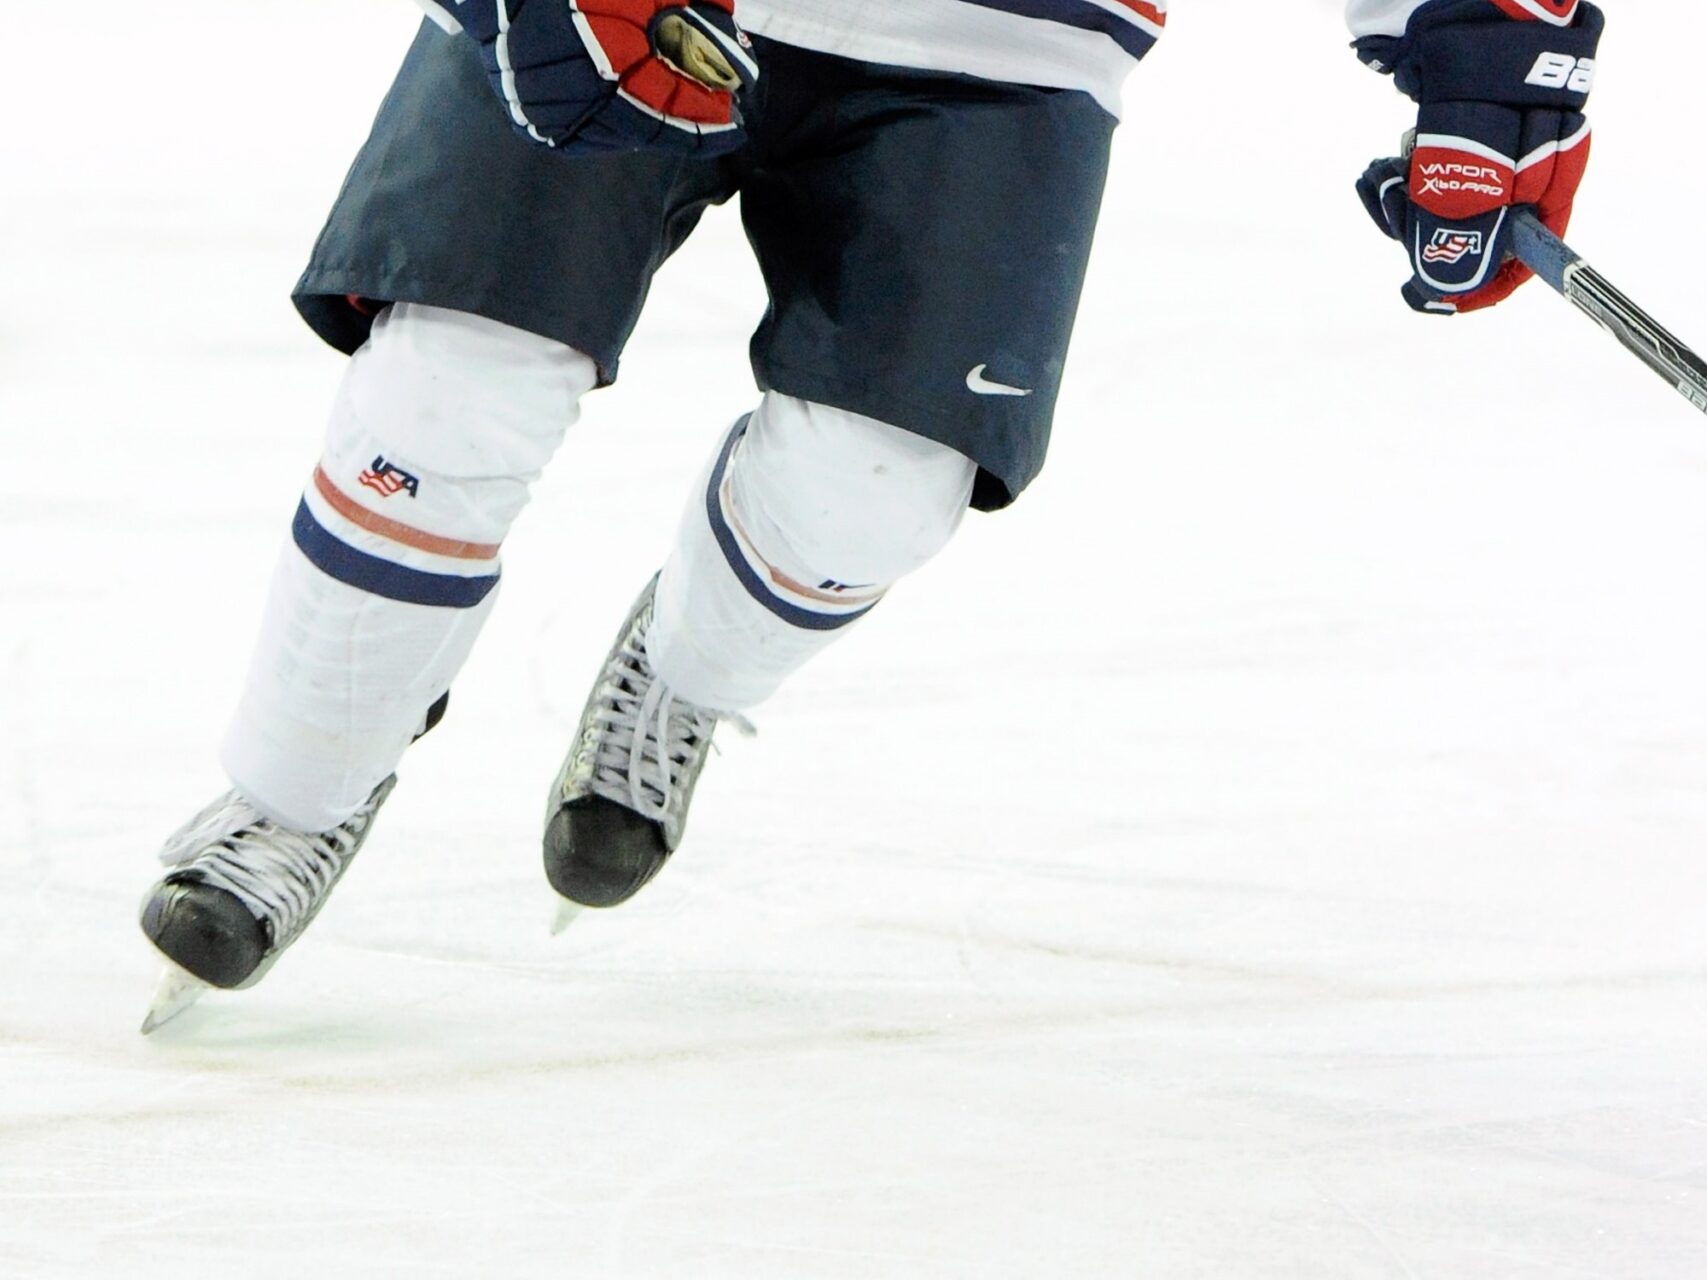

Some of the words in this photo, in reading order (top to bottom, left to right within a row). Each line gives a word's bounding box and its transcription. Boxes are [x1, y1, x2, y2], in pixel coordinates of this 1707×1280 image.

[1418, 163, 1503, 184] VAPOR
[1422, 227, 1482, 264] USA
[358, 454, 420, 499] USA
